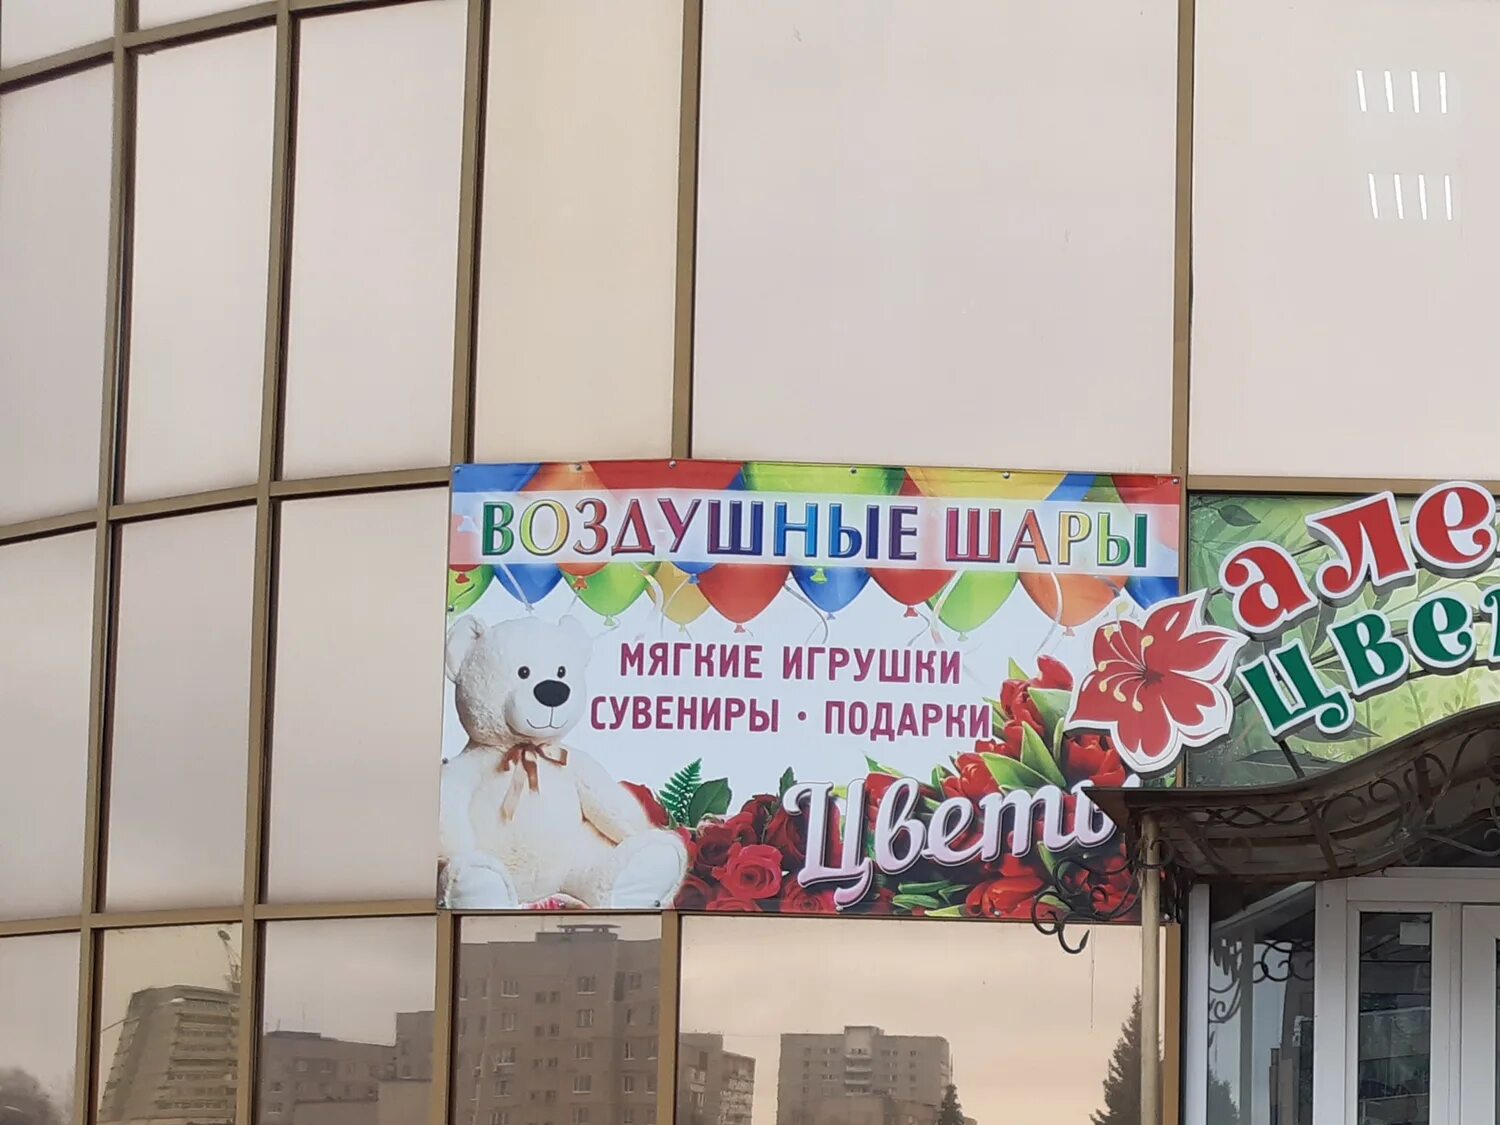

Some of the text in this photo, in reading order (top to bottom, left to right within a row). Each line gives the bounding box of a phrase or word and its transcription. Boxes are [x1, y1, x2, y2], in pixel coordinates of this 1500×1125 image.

[480, 498, 1150, 569] ВОЗДУШНЫЕ ШАРЫ
[619, 642, 962, 684] МЯГКИЕ ИГРУШКИ
[590, 696, 993, 741] СУВЕНИРЫ ПОДАРКИ
